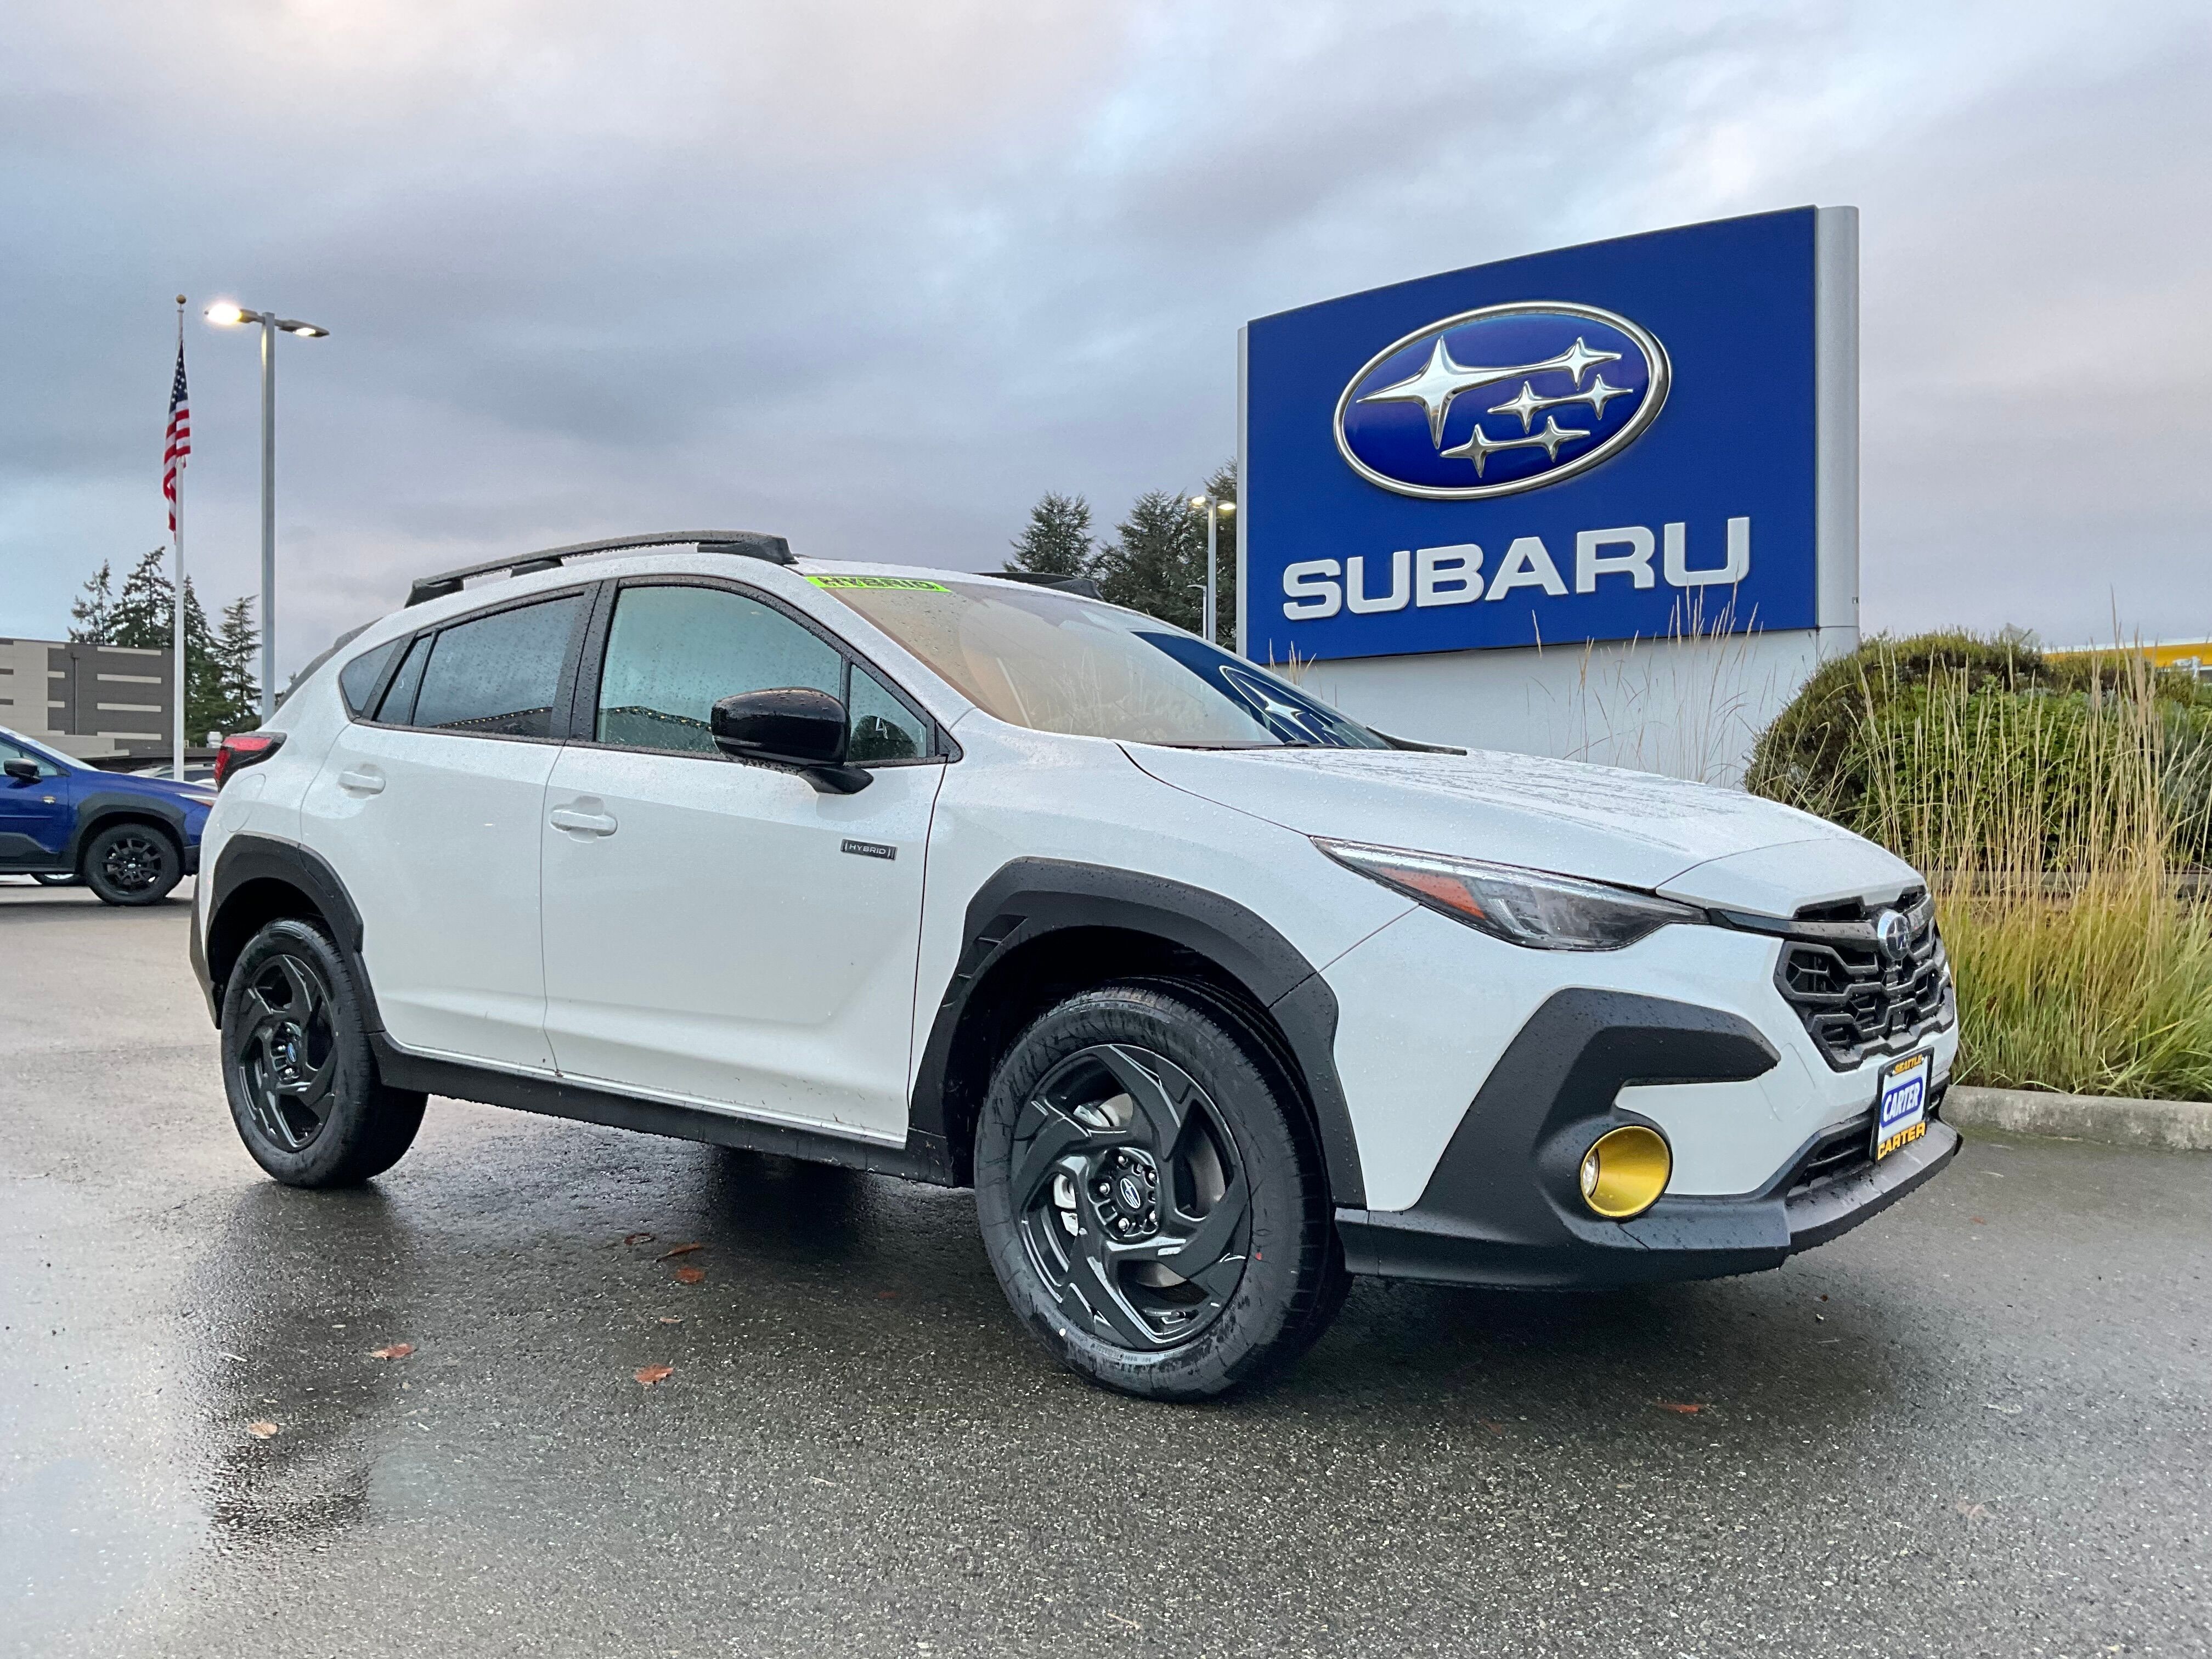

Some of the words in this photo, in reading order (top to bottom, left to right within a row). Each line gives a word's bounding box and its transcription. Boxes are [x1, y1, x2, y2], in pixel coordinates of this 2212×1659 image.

[1283, 517, 1750, 620] SUBARU
[848, 843, 887, 855] HYBRID
[1894, 1054, 1923, 1073] SEATTLE
[1883, 1082, 1921, 1122] CARTER
[1877, 1121, 1926, 1160] CARTER
